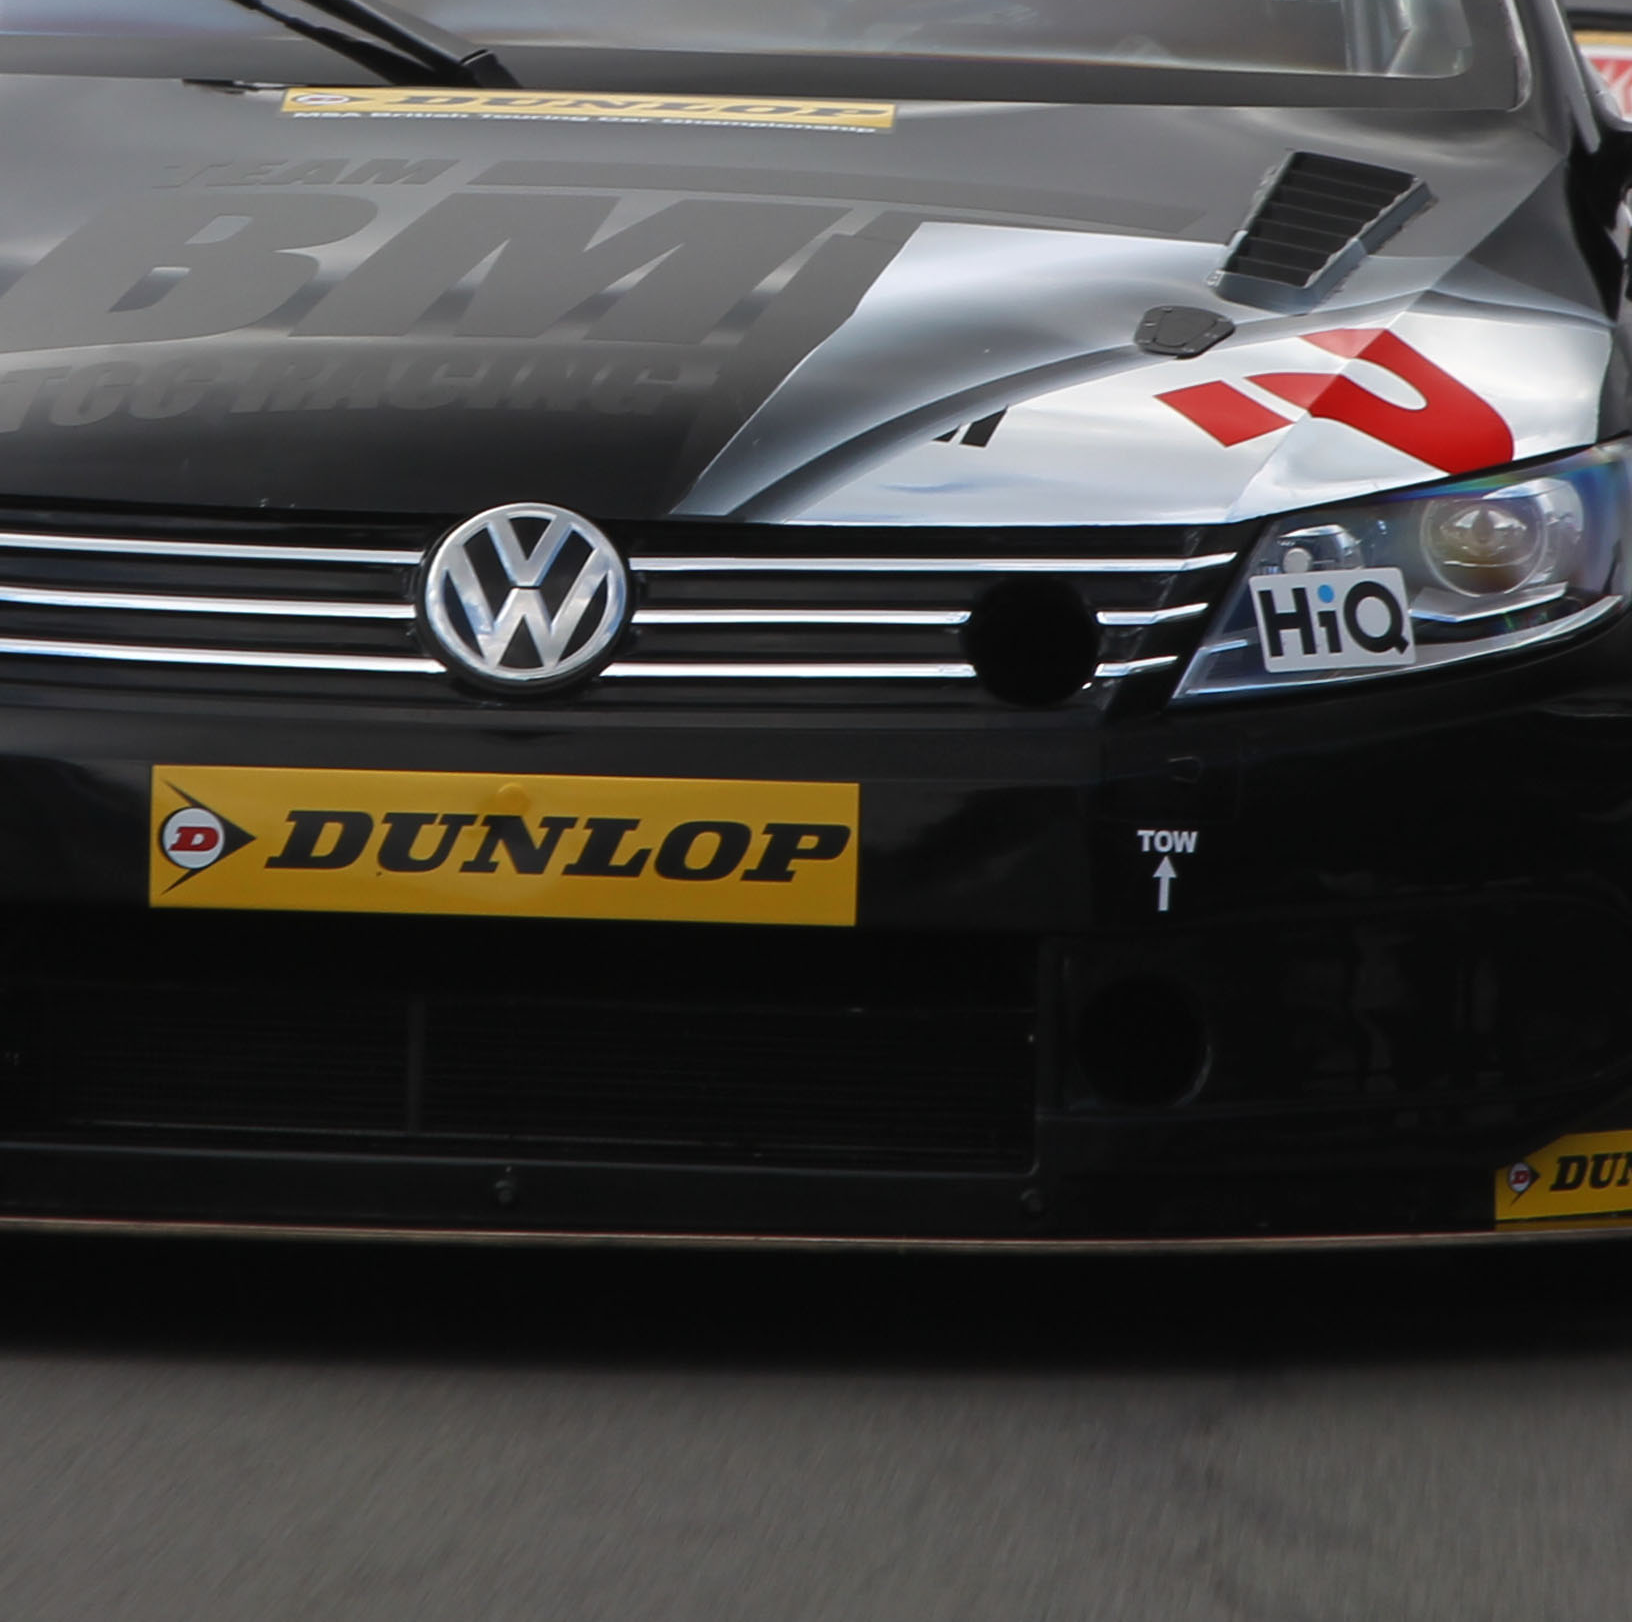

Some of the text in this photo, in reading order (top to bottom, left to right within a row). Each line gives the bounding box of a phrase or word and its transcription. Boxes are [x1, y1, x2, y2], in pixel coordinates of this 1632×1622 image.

[386, 95, 889, 118] DUNLOP
[1257, 581, 1409, 658] HiQ
[264, 808, 852, 883] DUNLOP
[1137, 829, 1199, 853] TOW
